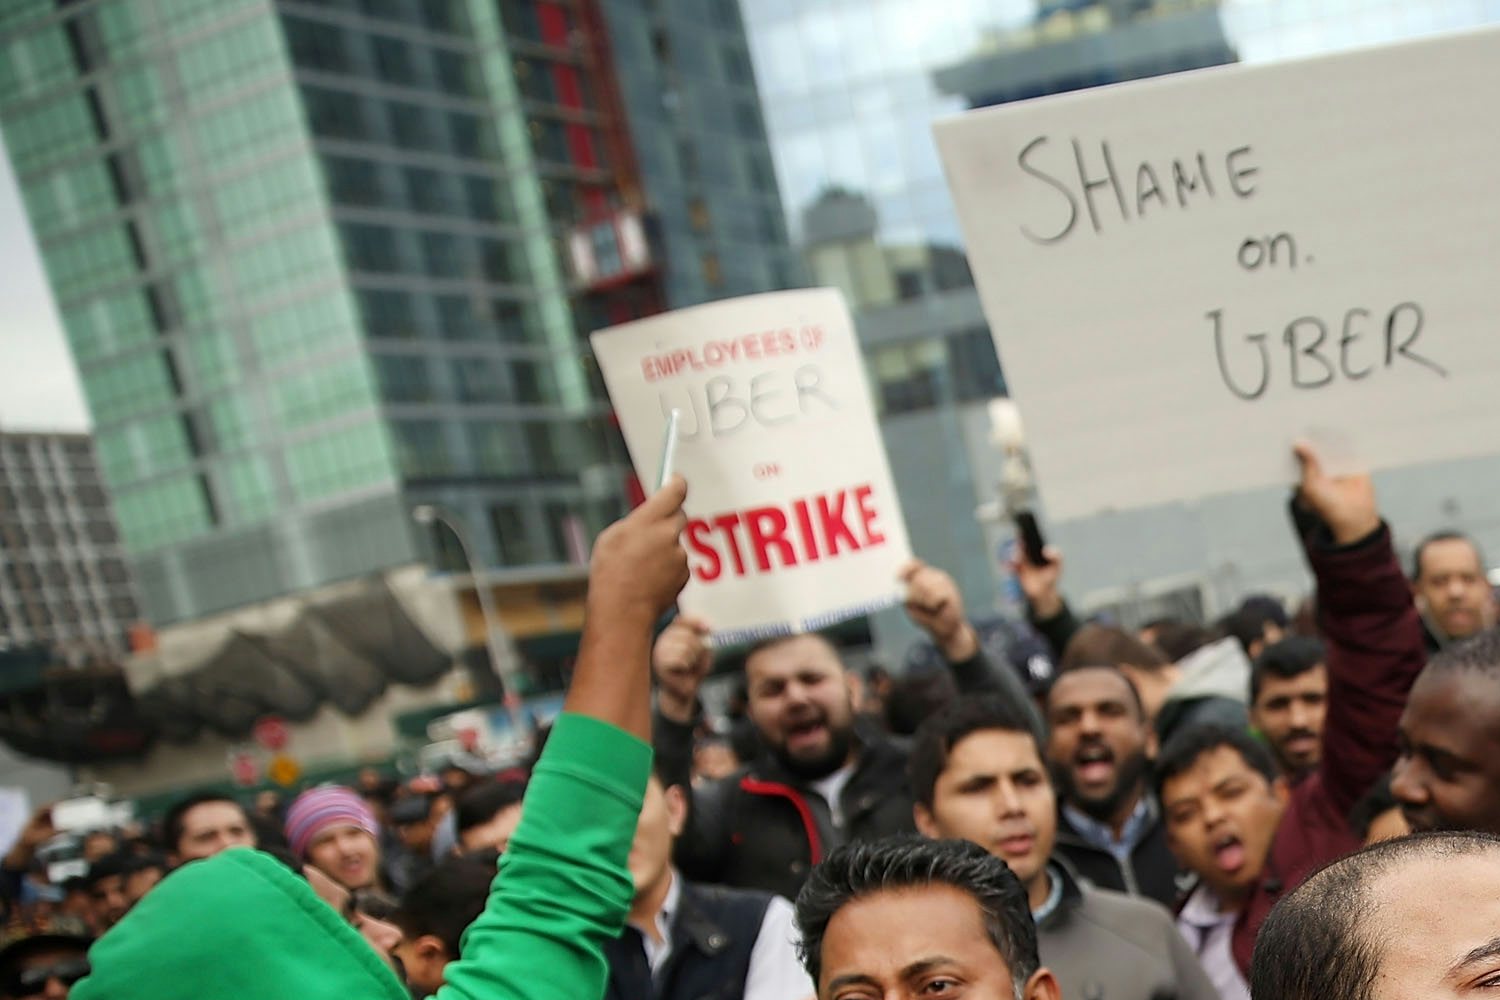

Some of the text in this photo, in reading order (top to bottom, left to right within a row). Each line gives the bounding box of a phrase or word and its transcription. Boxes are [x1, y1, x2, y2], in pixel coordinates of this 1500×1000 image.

[1017, 135, 1261, 246] SHAME
[641, 325, 825, 382] EMPLOYEES OF
[1205, 301, 1450, 401] UBER
[657, 363, 843, 440] UBER
[685, 483, 886, 583] STRIKE
